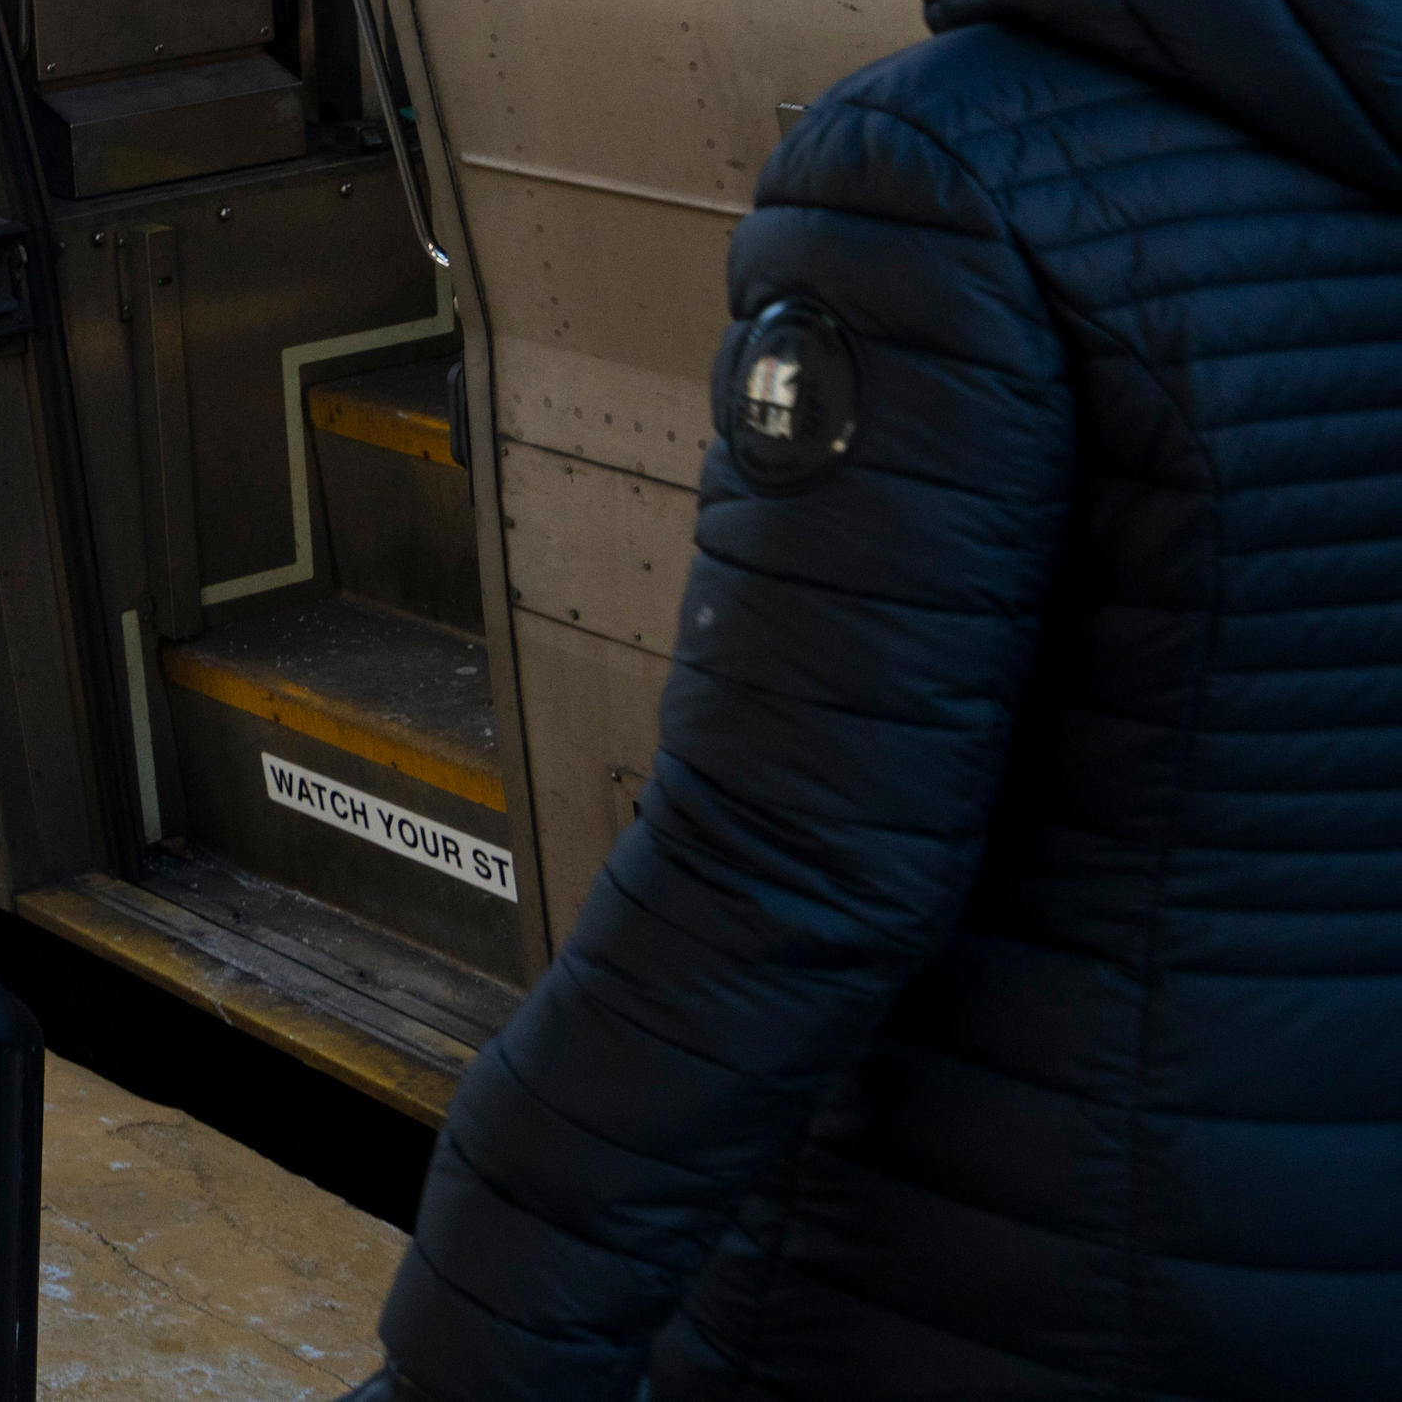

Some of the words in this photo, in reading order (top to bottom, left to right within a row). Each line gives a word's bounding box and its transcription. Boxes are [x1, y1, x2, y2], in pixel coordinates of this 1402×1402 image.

[270, 764, 370, 830] WATCH
[376, 811, 461, 870] YOUR
[472, 847, 512, 889] ST
